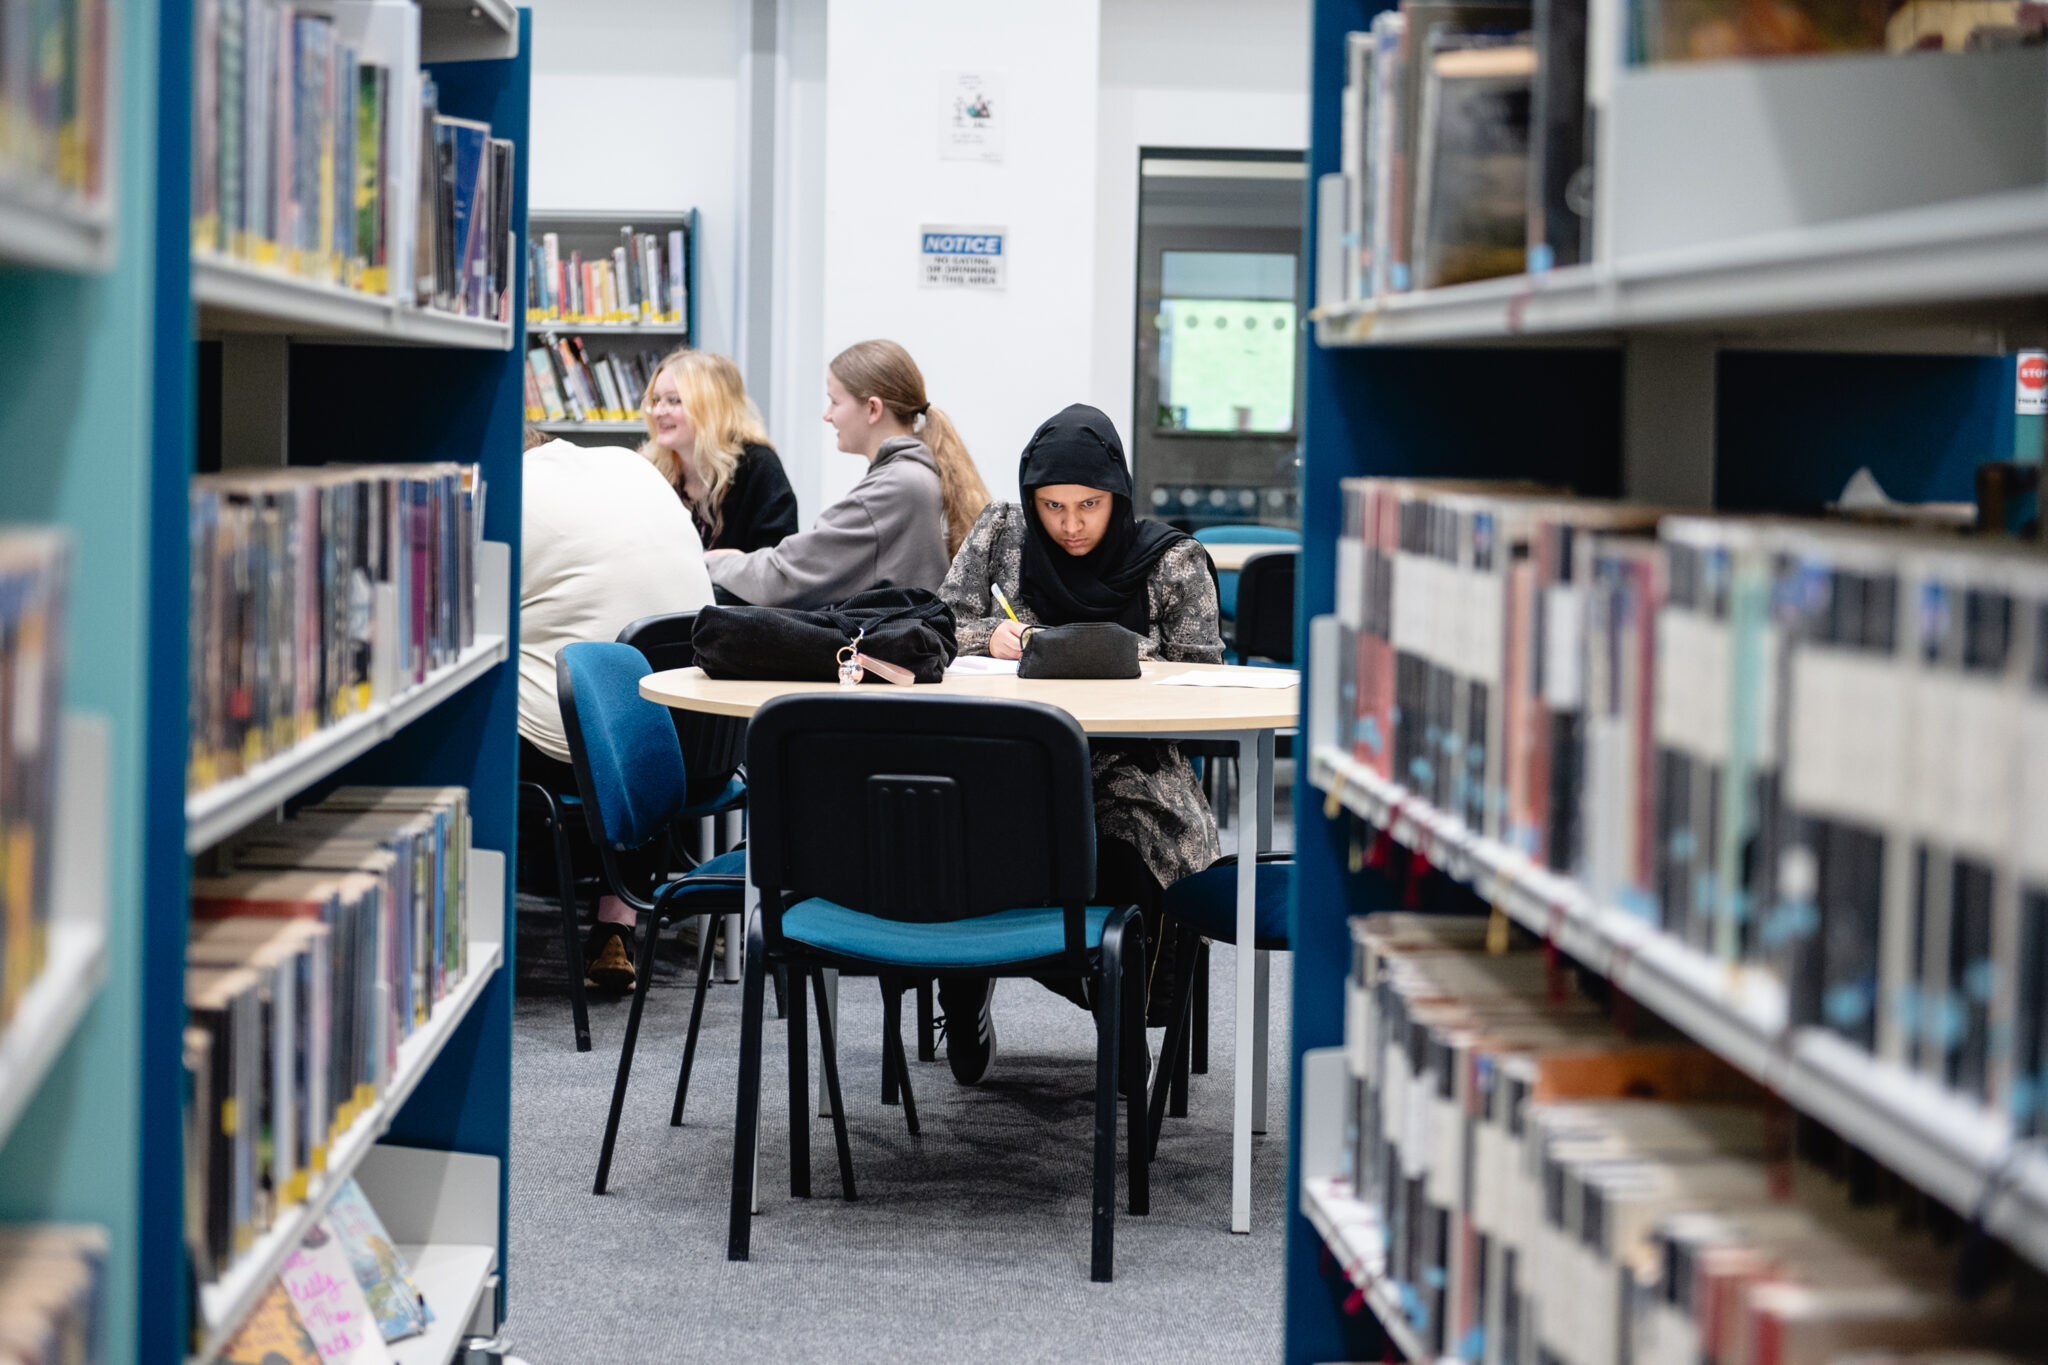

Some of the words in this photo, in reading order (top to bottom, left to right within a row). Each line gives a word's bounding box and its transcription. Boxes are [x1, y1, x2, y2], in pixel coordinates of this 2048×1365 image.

[925, 236, 1000, 253] NOTICE
[935, 256, 949, 264] NO
[952, 257, 991, 265] EATING
[926, 265, 941, 273] OR
[945, 266, 997, 275] DRINKING
